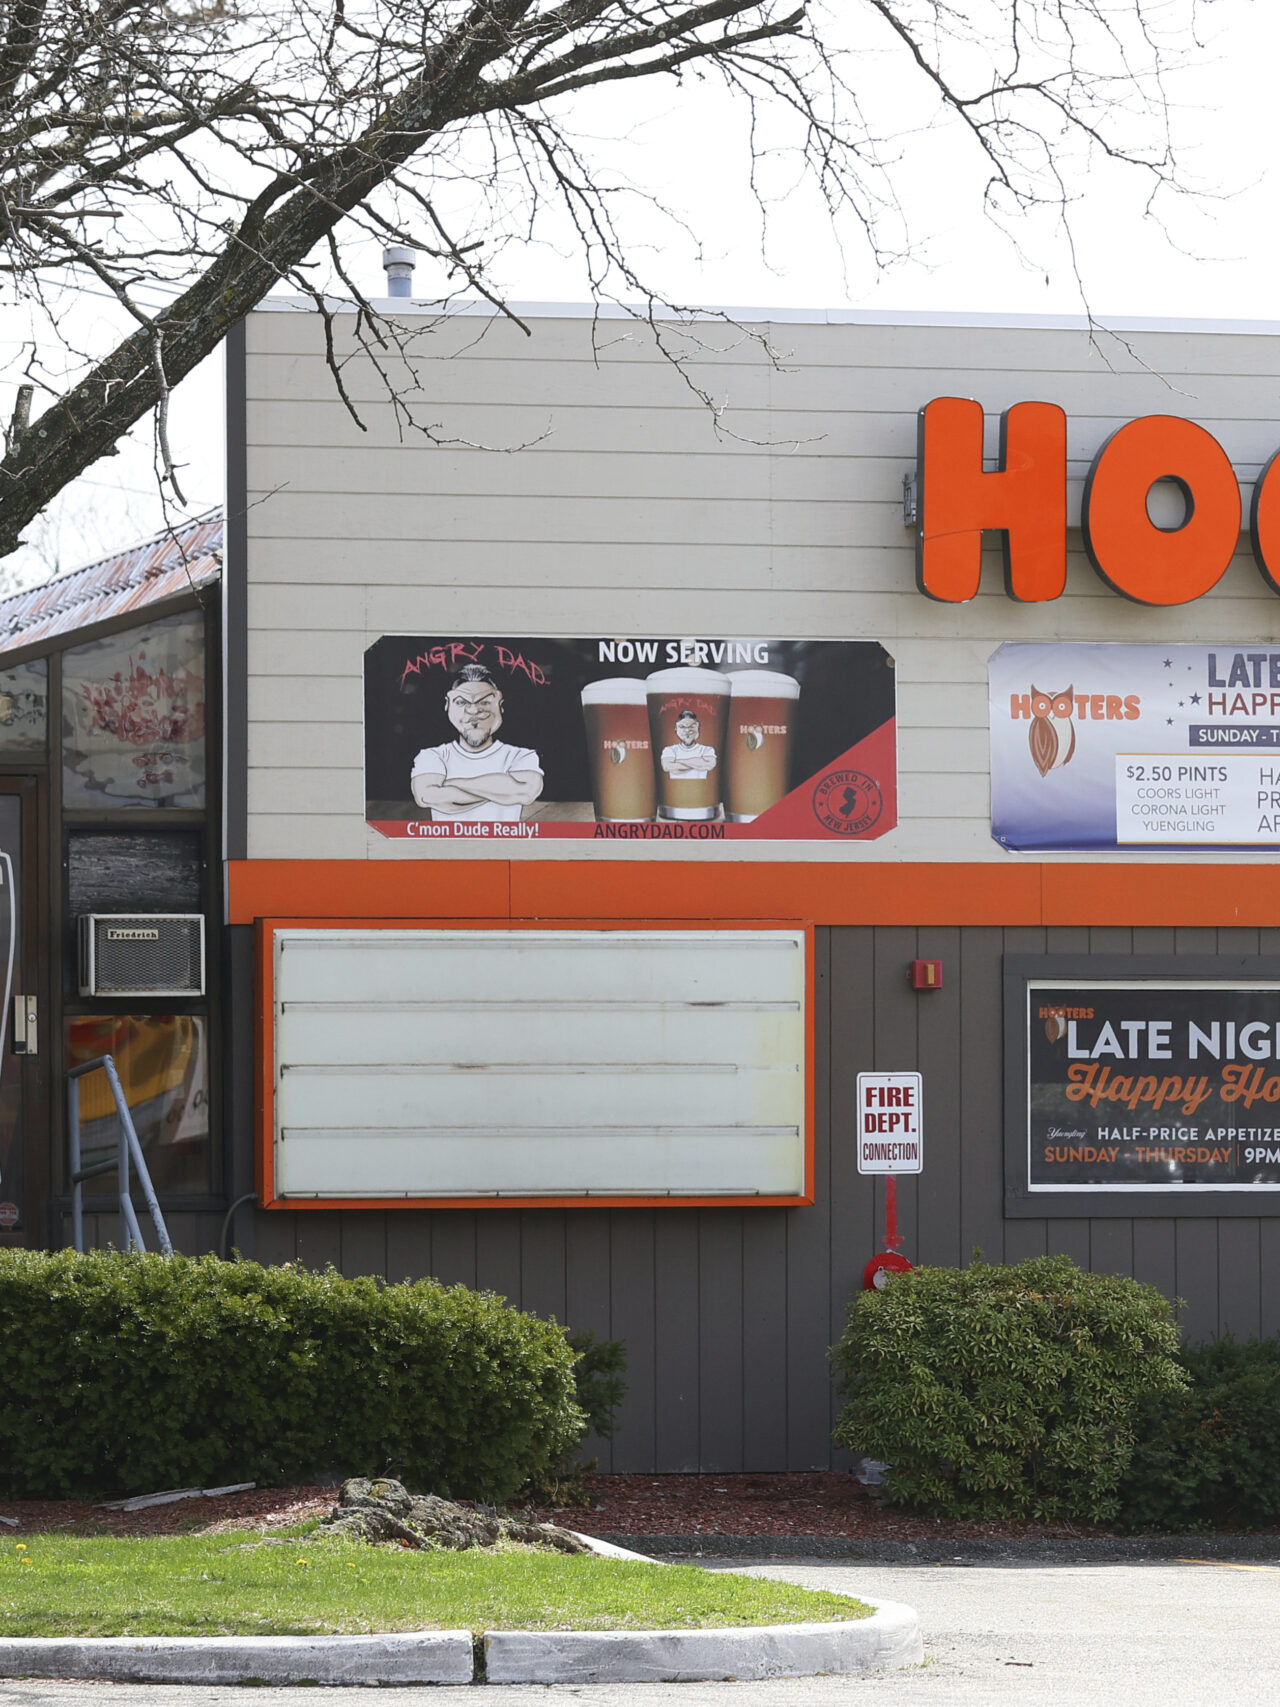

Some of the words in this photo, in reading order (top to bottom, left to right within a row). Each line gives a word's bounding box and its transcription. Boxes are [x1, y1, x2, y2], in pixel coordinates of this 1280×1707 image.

[598, 641, 659, 664] NOW
[665, 642, 769, 664] SERVING
[401, 641, 485, 690] ANGRY
[494, 645, 547, 685] DAD
[1010, 692, 1141, 721] HOOTERS
[740, 724, 787, 735] HOOTERS
[1198, 728, 1260, 743] SUNDAY
[604, 739, 649, 750] HOOTERS
[1126, 765, 1172, 782] $2.50
[1178, 766, 1228, 782] PINTS
[819, 774, 858, 795] BREWED
[861, 780, 874, 792] IN
[1137, 788, 1182, 799] COORS
[1185, 788, 1221, 799] LIGHT
[1131, 804, 1188, 816] CORONA
[1191, 804, 1227, 816] LIGHT
[406, 822, 450, 836] C'mon
[454, 823, 489, 837] Dude
[493, 823, 539, 839] Really!
[594, 823, 726, 839] ANGRYDAD.COM
[1142, 820, 1216, 832] YUENGLING
[109, 930, 157, 939] Friedrich
[1038, 1007, 1095, 1019] HOOTERS
[1067, 1020, 1173, 1060] LATE
[865, 1086, 915, 1108] FIRE
[1065, 1062, 1213, 1116] Happy
[864, 1112, 917, 1134] DEPT.
[1046, 1127, 1088, 1140] Yuengling
[1097, 1127, 1199, 1142] HALF-PRICE
[863, 1142, 918, 1161] CONNECTION
[1045, 1146, 1120, 1163] SUNDAY
[1136, 1147, 1233, 1164] THURSDAY
